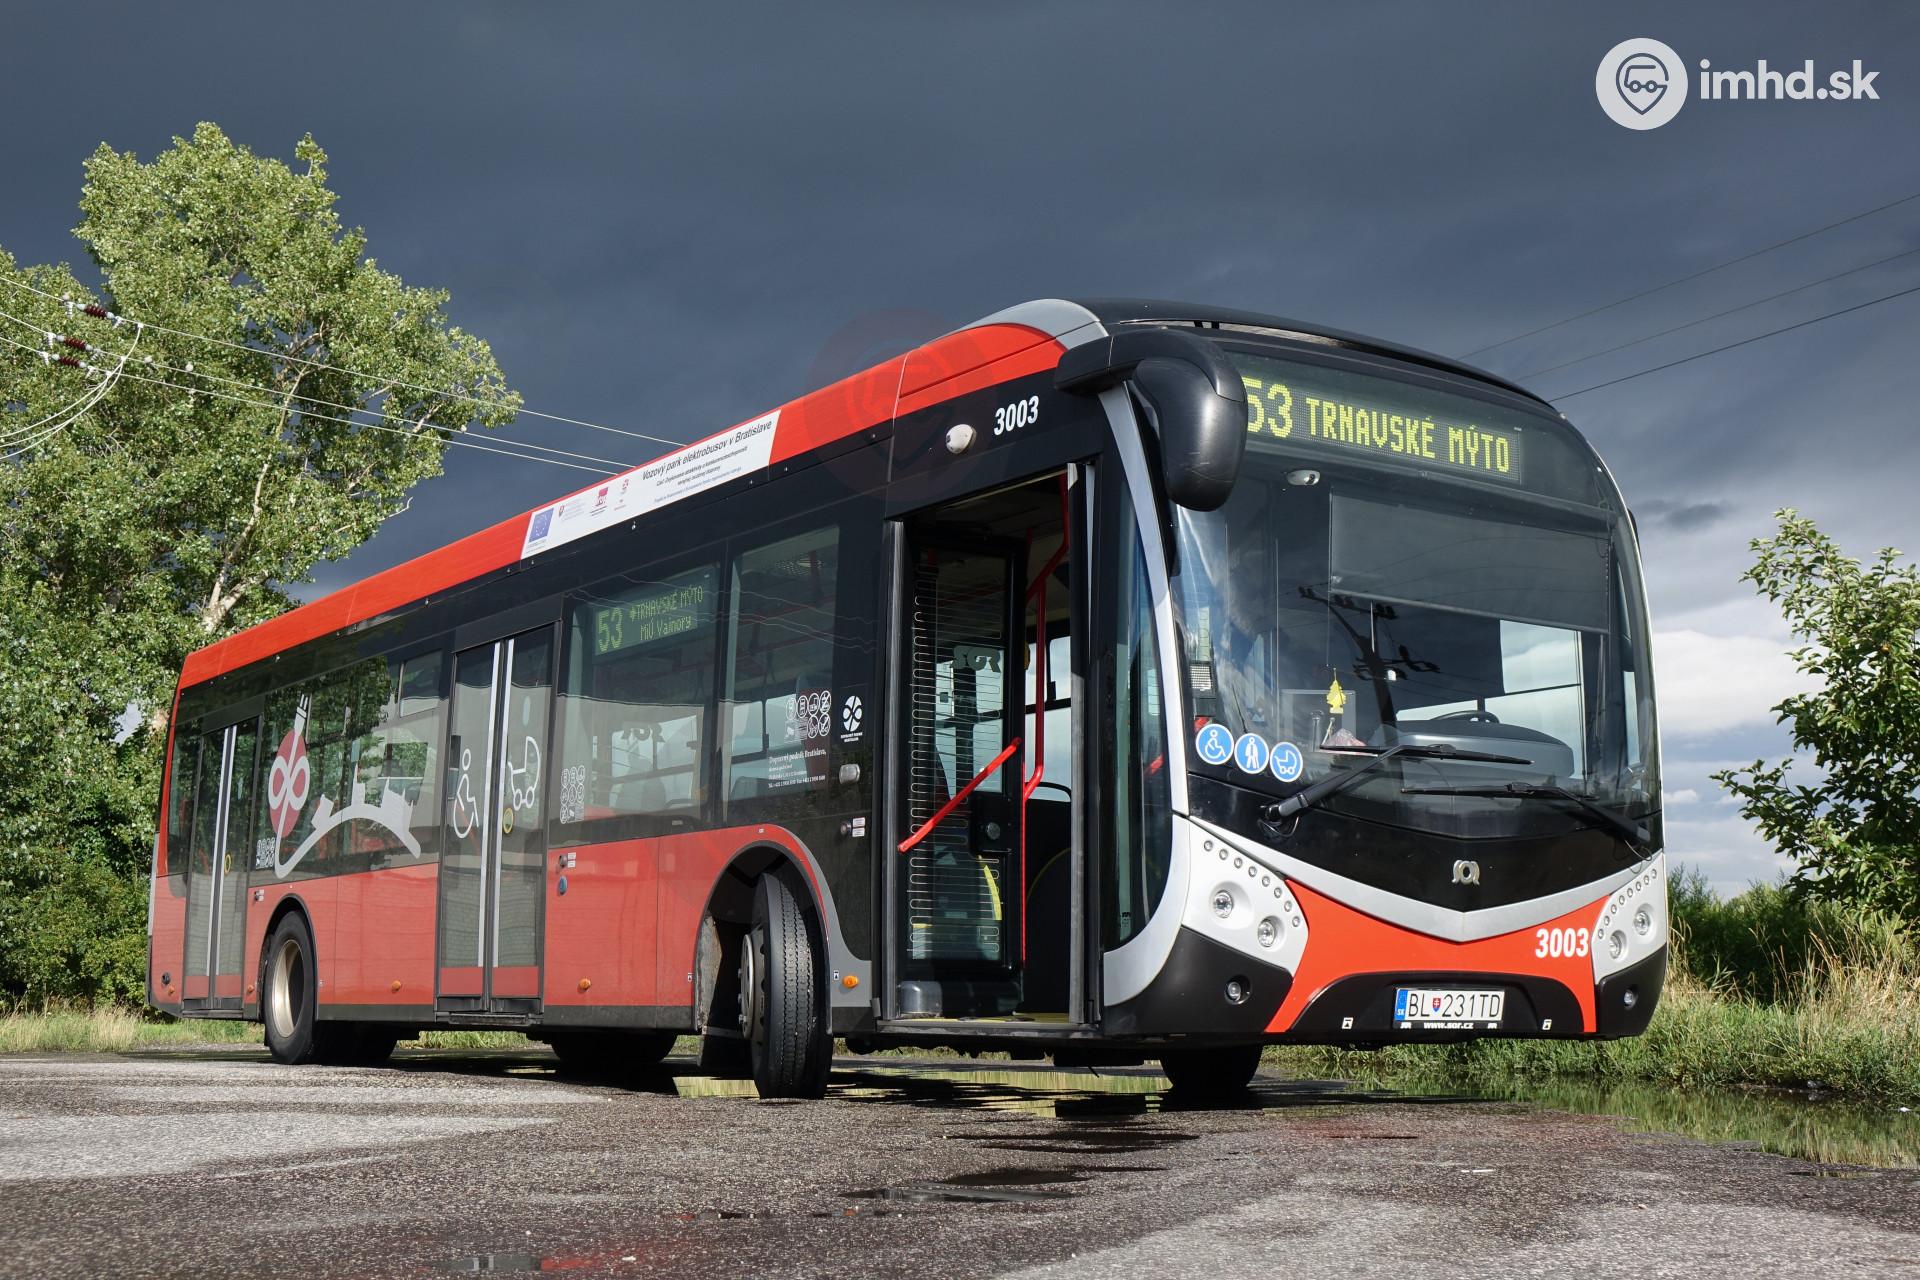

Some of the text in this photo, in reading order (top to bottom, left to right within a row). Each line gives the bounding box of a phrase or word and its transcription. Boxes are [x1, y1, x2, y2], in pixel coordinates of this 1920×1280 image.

[994, 395, 1039, 435] 3003
[1241, 376, 1510, 473] 53 TRNAVSKÉ MÝTO
[642, 465, 667, 481] Vozový
[665, 457, 682, 473] park
[682, 440, 728, 465] elektrobusov
[735, 421, 772, 443] Bratislave
[599, 607, 622, 652] 53
[1535, 928, 1589, 958] 3003
[1408, 994, 1430, 1017] BL
[1441, 994, 1501, 1018] 231TD
[1423, 1021, 1474, 1030] www.sor.cz
